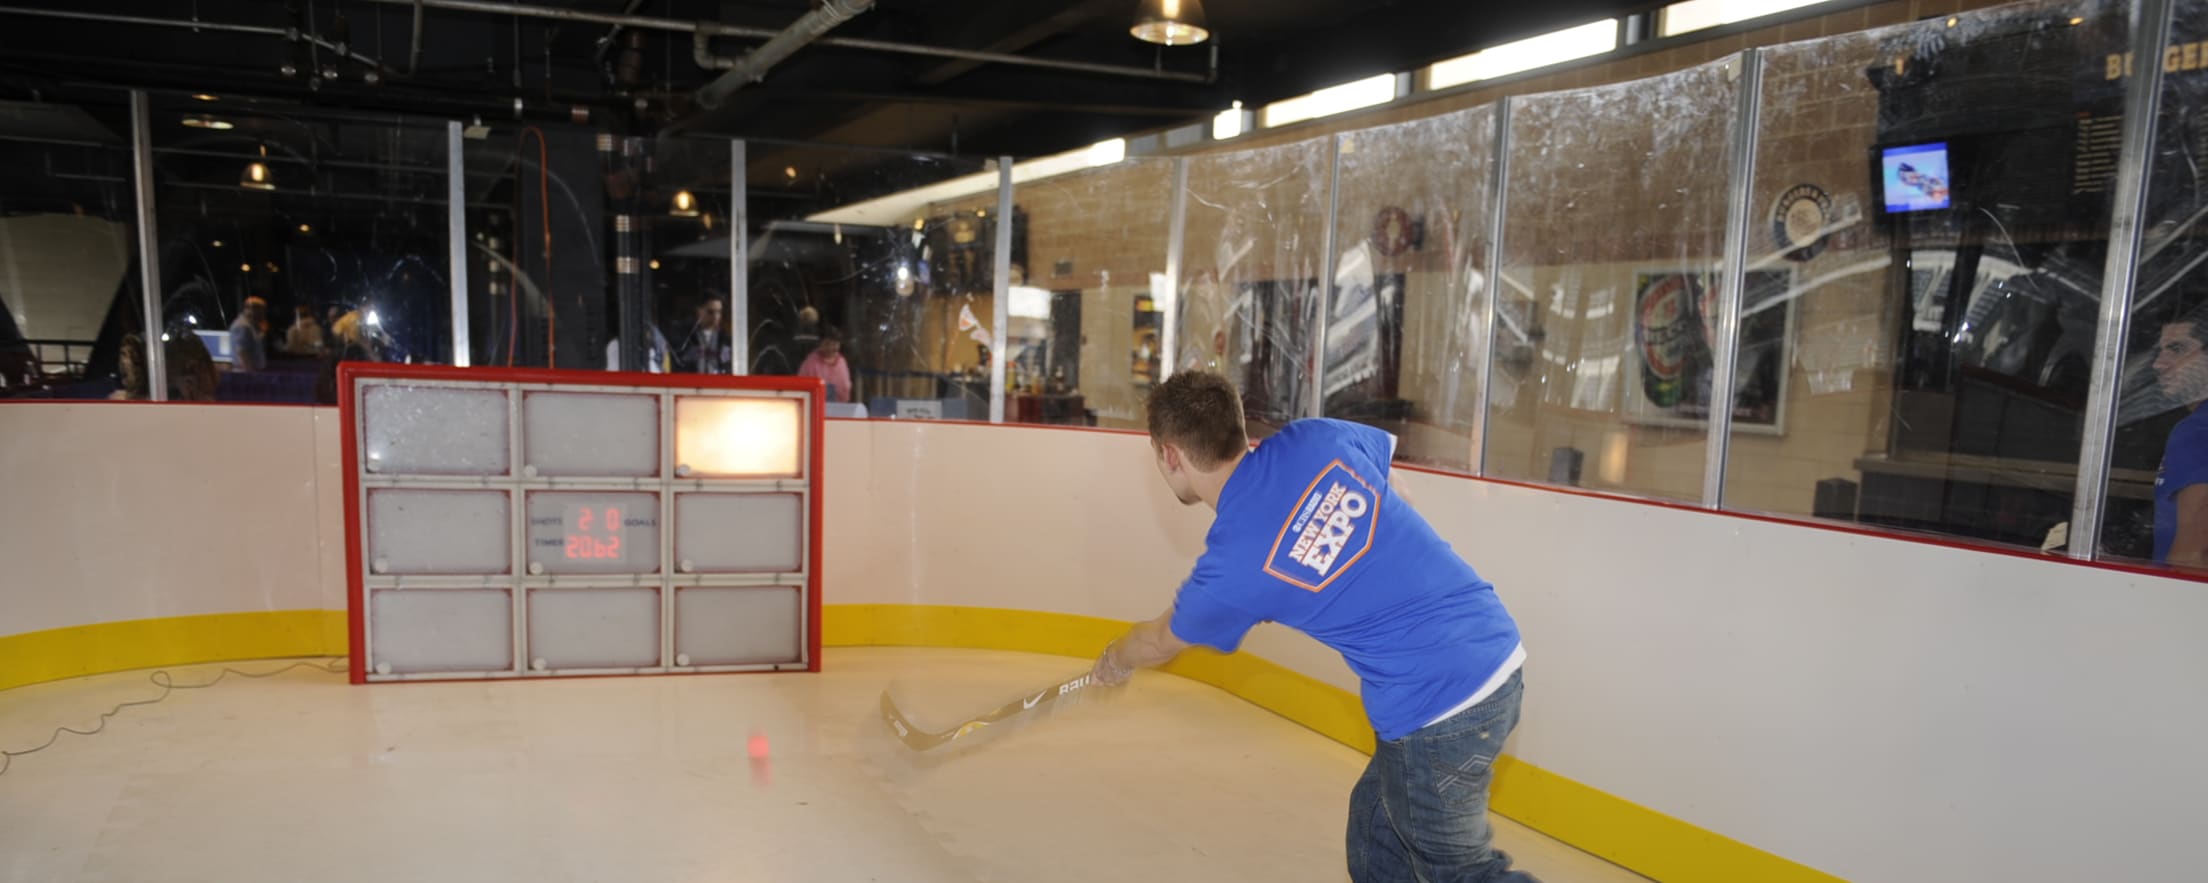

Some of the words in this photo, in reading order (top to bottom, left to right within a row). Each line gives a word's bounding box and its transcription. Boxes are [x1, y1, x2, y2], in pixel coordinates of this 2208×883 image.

[605, 507, 620, 531] 0
[1288, 520, 1321, 562] NEW
[1312, 480, 1347, 522] YORK
[1302, 491, 1367, 576] EXPO
